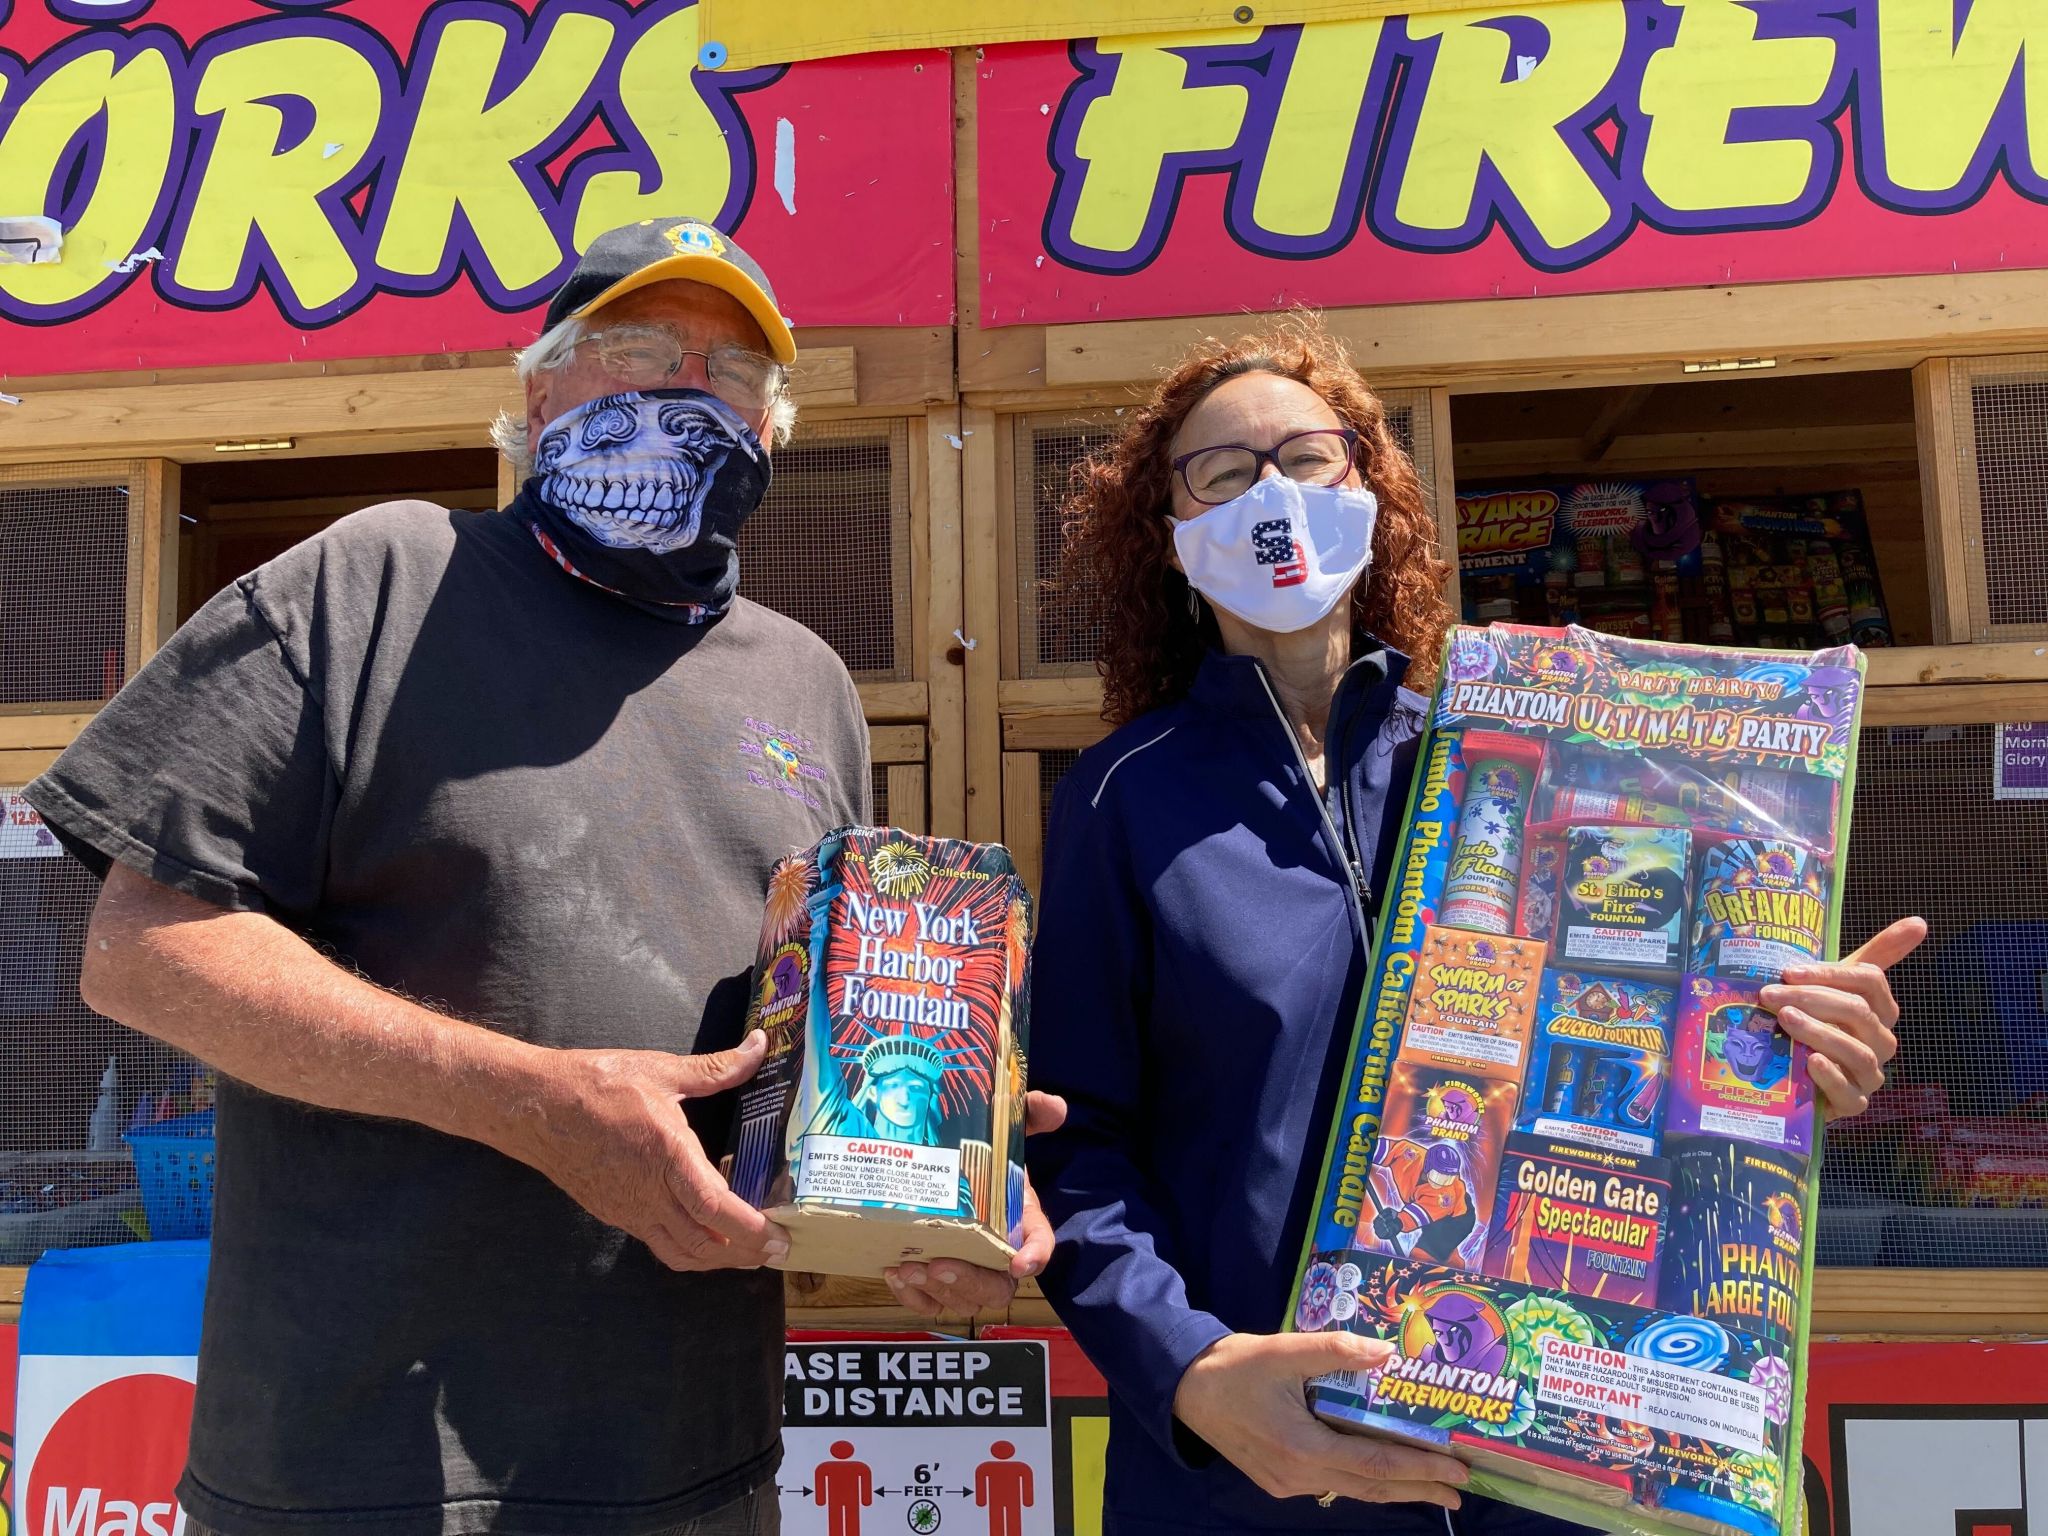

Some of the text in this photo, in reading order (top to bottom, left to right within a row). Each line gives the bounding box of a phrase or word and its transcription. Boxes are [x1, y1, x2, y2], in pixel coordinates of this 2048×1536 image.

[0, 5, 731, 309] ORKS
[1456, 492, 1556, 526] YARD
[1577, 507, 1628, 518] FIREWORKS
[1457, 520, 1550, 554] RAGE
[1537, 668, 1578, 679] PHANTOM
[1618, 673, 1781, 699] PARTY HEARTY!
[1453, 685, 1827, 755] PHANTOM ULTIMATE PARTY
[1421, 729, 1461, 812] Jumbo
[2005, 753, 2046, 768] Glory
[1455, 835, 1498, 857] Jade
[844, 851, 866, 863] The
[930, 865, 990, 881] Collection
[1758, 872, 1796, 884] PHANTOM
[1391, 820, 1443, 944] Phantom
[1462, 874, 1504, 888] FOUNTAIN
[1577, 882, 1664, 900] St. Elmo's
[1762, 878, 1791, 888] BRAND
[842, 890, 981, 945] New York
[1467, 899, 1497, 911] CAUTION
[1602, 899, 1636, 914] Fire
[1590, 913, 1646, 925] FOUNTAIN
[1592, 933, 1626, 942] SHOWERS
[1638, 937, 1667, 945] SPARKS
[1594, 928, 1642, 938] CAUTION
[1723, 940, 1760, 948] CAUTION
[1755, 925, 1814, 951] FOUNTAIN
[856, 935, 966, 986] Harbor
[1466, 955, 1496, 964] PHANTOM
[1429, 963, 1526, 993] SWARM OF
[759, 992, 802, 1020] PHANTOM
[840, 974, 970, 1030] Fountain
[1431, 988, 1511, 1020] SPARKS
[763, 1008, 794, 1029] BRAND
[1358, 951, 1416, 1104] California
[1440, 1014, 1498, 1030] FOUNTAIN
[1411, 1024, 1519, 1049] CAUTION EMITS SHOWERS SPARKS
[1550, 1016, 1666, 1052] CUCKOO FOUNTAIN
[1431, 1054, 1466, 1066] FIREWORKS
[1444, 1080, 1486, 1115] FIREWORKS
[1425, 1116, 1479, 1135] PHANTOM
[1431, 1127, 1470, 1142] BRAND
[1544, 1125, 1565, 1133] EMITS
[1566, 1127, 1601, 1140] SHOWERS
[1614, 1138, 1644, 1149] SPARKS
[1570, 1123, 1618, 1137] CAUTION
[808, 1153, 951, 1174] EMITS SHOWERS OF SPARKS
[847, 1142, 914, 1160] CAUTION
[1550, 1145, 1637, 1168] FIREWORKS COM
[860, 1166, 885, 1174] UNDER
[886, 1169, 909, 1178] CLOSE
[911, 1172, 933, 1181] ADULT
[876, 1175, 910, 1185] OUTDOOR
[1333, 1113, 1381, 1228] Candle
[1744, 1156, 1797, 1183] FIREWORKS
[842, 1179, 865, 1187] LEVEL
[914, 1187, 929, 1195] NOT
[930, 1190, 950, 1198] HOLD
[845, 1187, 866, 1195] LIGHT
[868, 1189, 886, 1197] FUSE
[905, 1193, 918, 1201] GET
[1518, 1160, 1659, 1216] Golden Gate
[1537, 1197, 1650, 1249] Spectacular
[1586, 1250, 1647, 1279] FOUNTAIN
[1722, 1243, 1801, 1296] PHANTO
[1693, 1279, 1764, 1318] LARGE
[784, 1351, 992, 1380] ASE KEEP
[1382, 1355, 1519, 1401] PHANTOM
[1547, 1341, 1760, 1404] CAUTION THIS ASSORTMENT CONTAINS ITEMS
[1544, 1363, 1692, 1403] ONLY UNDER CLOSE ADULT SUPERVISION.
[1546, 1355, 1759, 1413] THAT MAY BE HAZARDOUS MISUSED AND SHOULD BE USED
[803, 1387, 1024, 1416] DISTANCE
[1377, 1375, 1514, 1422] FIREWORKS
[1541, 1390, 1608, 1412] ITEMS CAREFULLY.
[1543, 1374, 1760, 1442] IMPORTANT READ CAUTIONS ON INDIVIDUAL
[1543, 1411, 1589, 1428] Phantom Designs
[1612, 1426, 1627, 1436] Made
[1582, 1433, 1638, 1452] Consumer Fireworks
[1543, 1435, 1723, 1484] violation Federal product manner inconsistent
[1659, 1446, 1753, 1478] FIREWORKS COM
[903, 1485, 944, 1497] FEET
[43, 1486, 188, 1536] Mas
